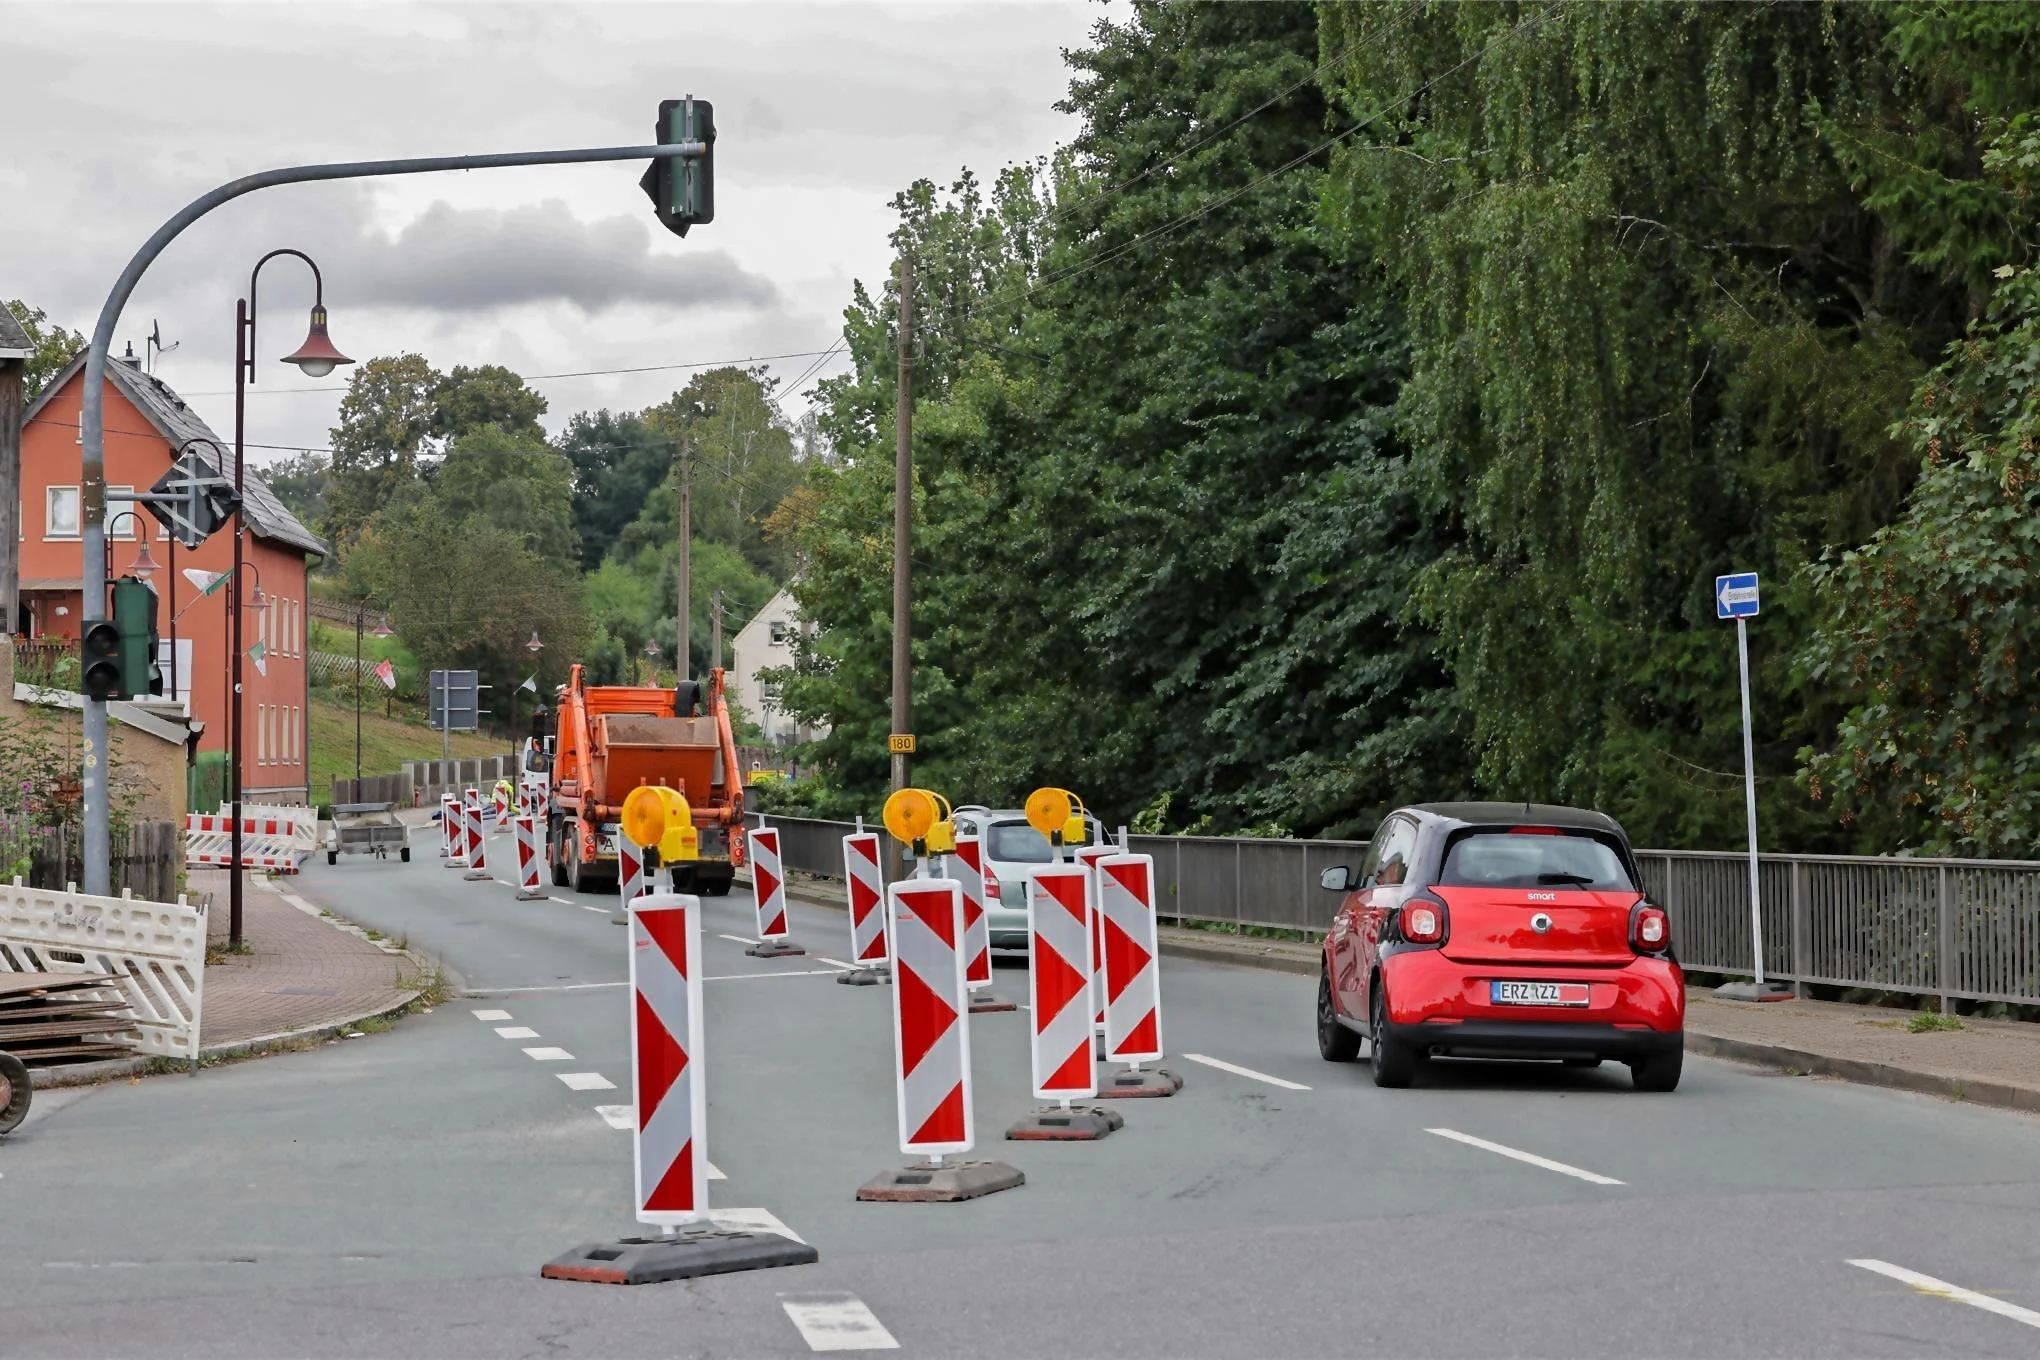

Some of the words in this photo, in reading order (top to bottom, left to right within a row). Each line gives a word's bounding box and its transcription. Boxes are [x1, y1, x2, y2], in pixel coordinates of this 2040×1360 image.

[892, 738, 911, 749] 180
[604, 838, 614, 851] A
[1502, 984, 1528, 999] ERZ
